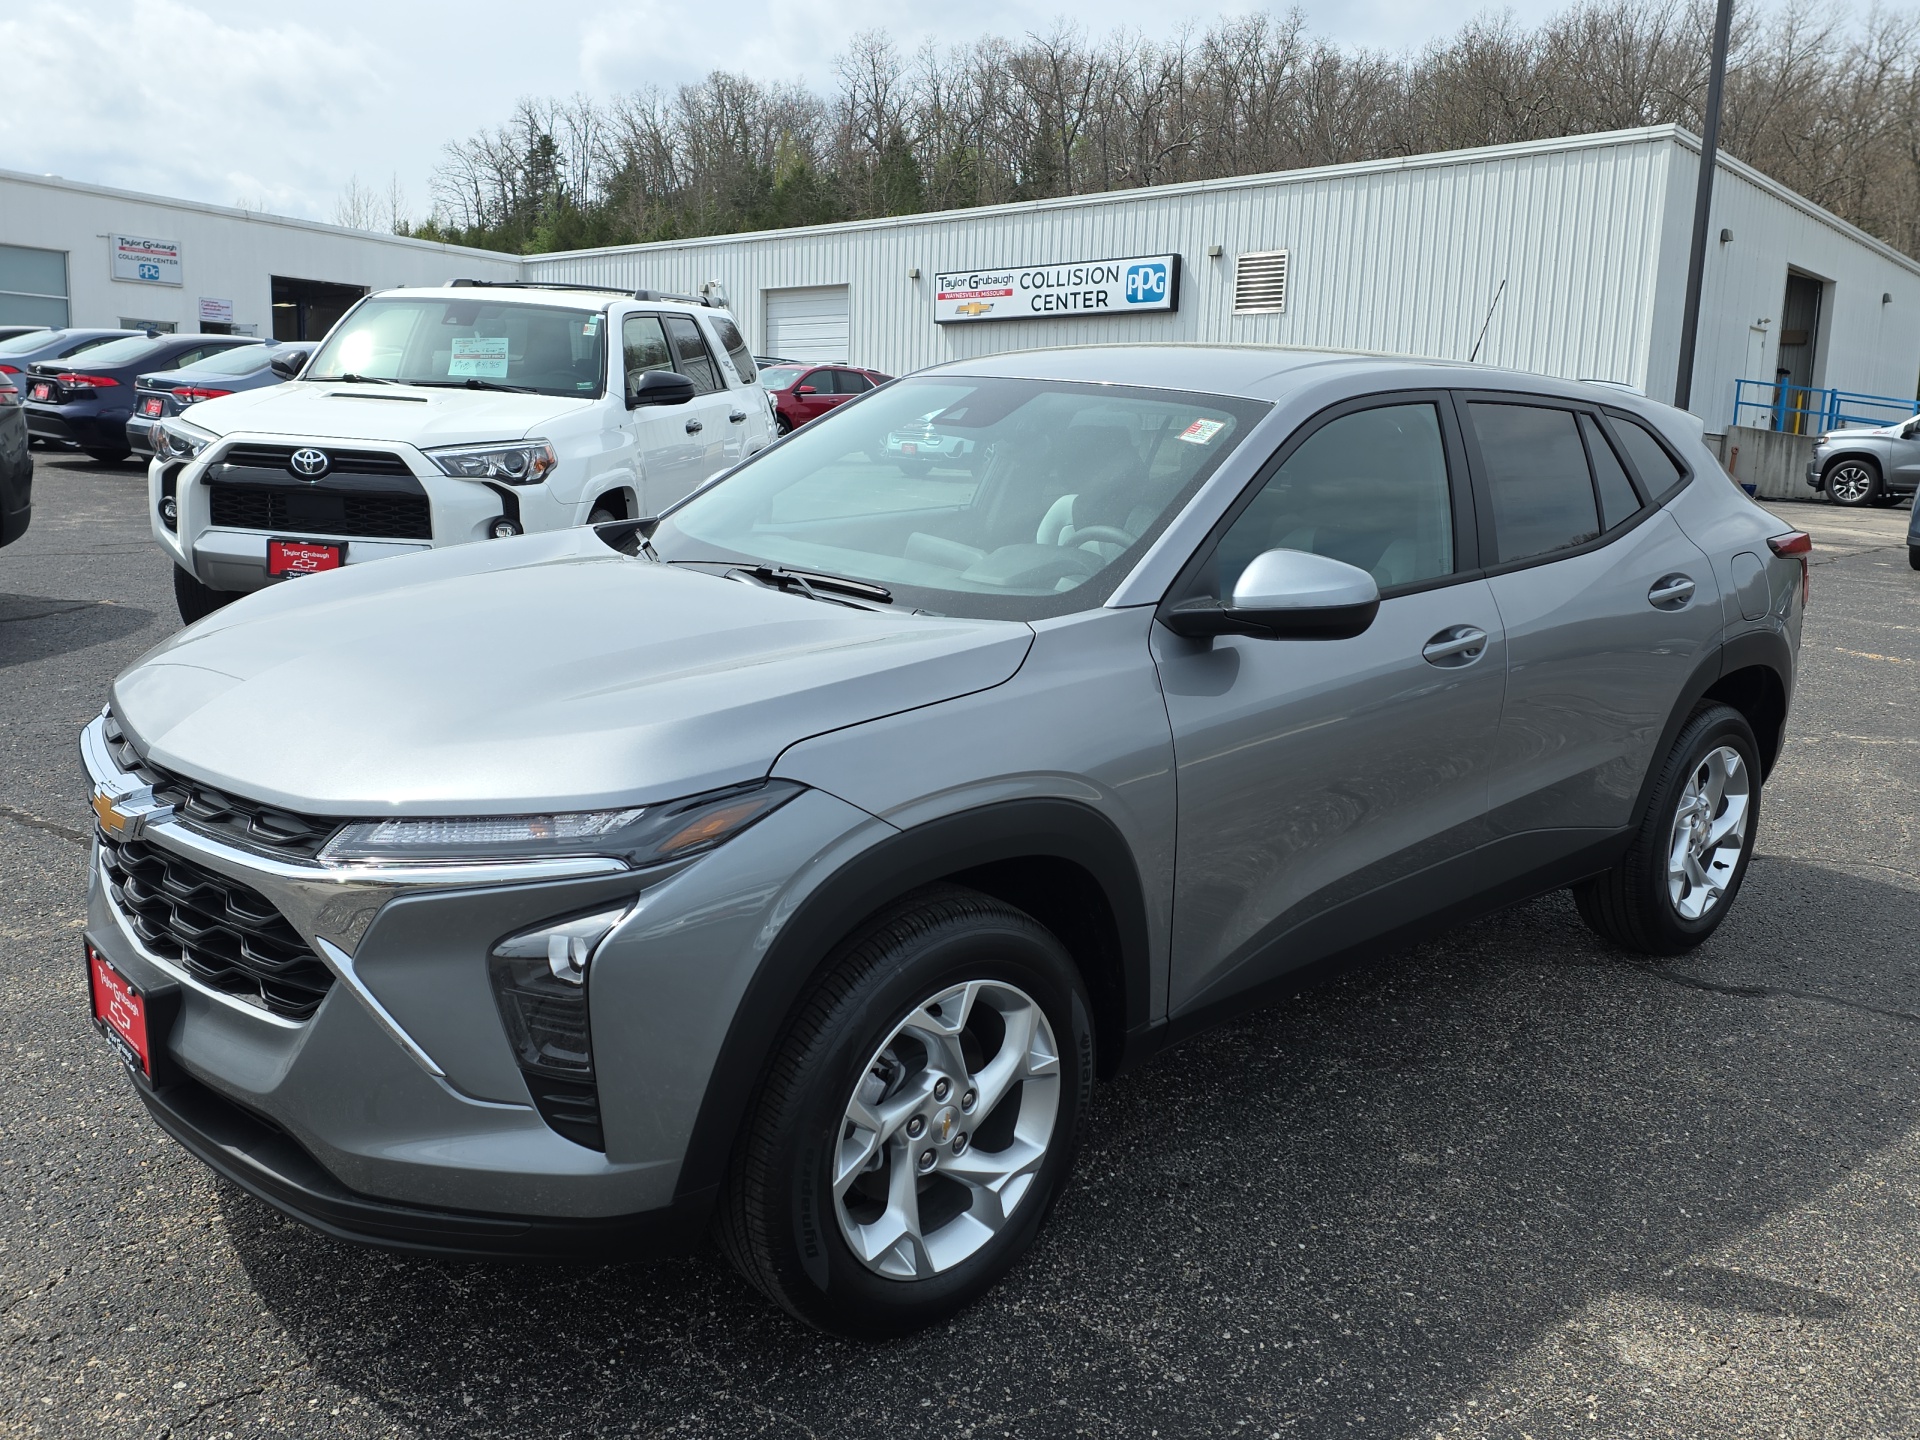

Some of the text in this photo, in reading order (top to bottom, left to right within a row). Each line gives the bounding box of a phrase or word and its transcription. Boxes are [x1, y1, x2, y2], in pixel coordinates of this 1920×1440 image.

[118, 237, 141, 247] Taylor
[142, 240, 177, 252] Grubaugh
[118, 253, 178, 265] COLLISION CENTER
[139, 265, 159, 278] PPG
[1020, 265, 1119, 290] COLLISION
[938, 273, 1014, 293] Taylor Grubaugh
[1127, 267, 1165, 300] PPG
[1031, 290, 1108, 312] CENTER
[282, 549, 330, 559] Taylor Grubaugh
[98, 965, 113, 990] Taylor
[113, 983, 139, 1017] Grubaugh
